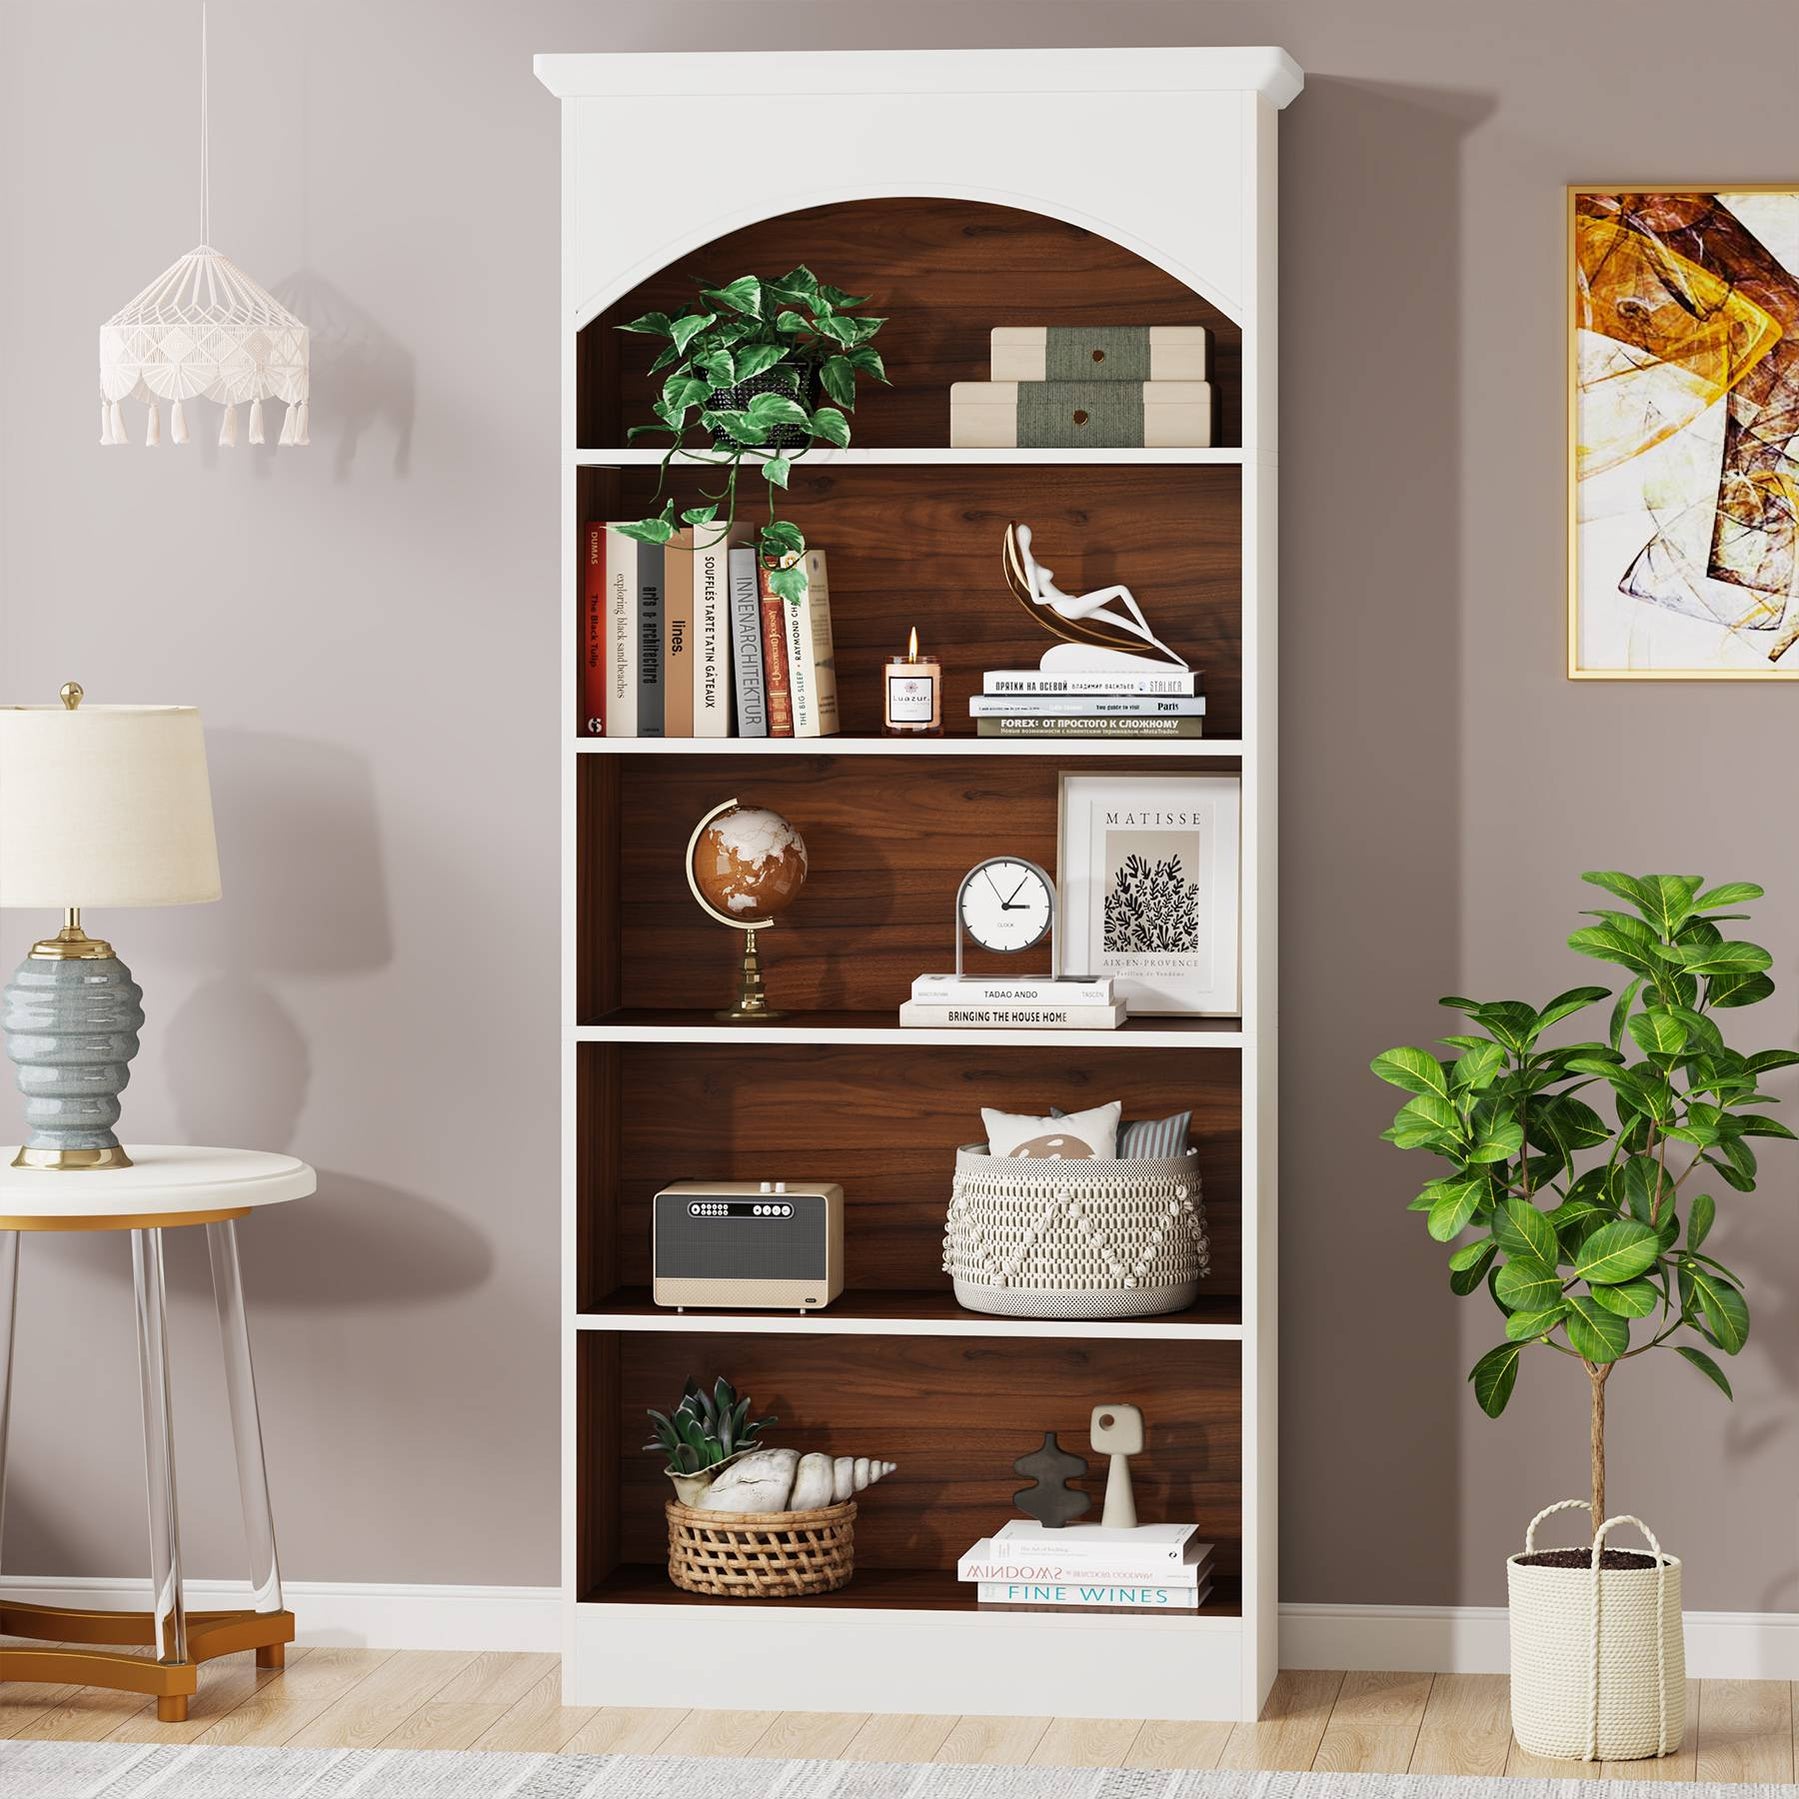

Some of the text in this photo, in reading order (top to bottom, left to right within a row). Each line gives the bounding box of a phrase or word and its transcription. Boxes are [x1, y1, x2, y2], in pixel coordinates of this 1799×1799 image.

[643, 586, 659, 606] arts
[590, 594, 598, 668] The Black Tulip
[614, 573, 627, 699] exploring black sand beaches
[672, 620, 686, 656] lines.
[705, 556, 718, 709] SOUFFLÉS TARTE TATIN GÂTEAUX
[791, 620, 802, 661] RAYMOND
[643, 623, 660, 684] architecture
[735, 577, 762, 726] INNENARCHITEKTUR
[796, 671, 805, 693] SLEEP
[1026, 681, 1036, 691] НА
[1039, 679, 1068, 691] ОСЕВОЙ
[1157, 702, 1179, 711] Paris
[799, 712, 807, 726] THE
[1001, 719, 1179, 728] FOREX: ОТ ПРОСТОГО К СЛОЖНОМУ
[1106, 813, 1201, 825] MATISSE
[984, 990, 1038, 998] TADAO ANDO
[948, 1011, 1067, 1022] BRINGING THE HOUSE HOME
[1008, 1585, 1067, 1601] FINE
[1080, 1587, 1168, 1604] WINES
